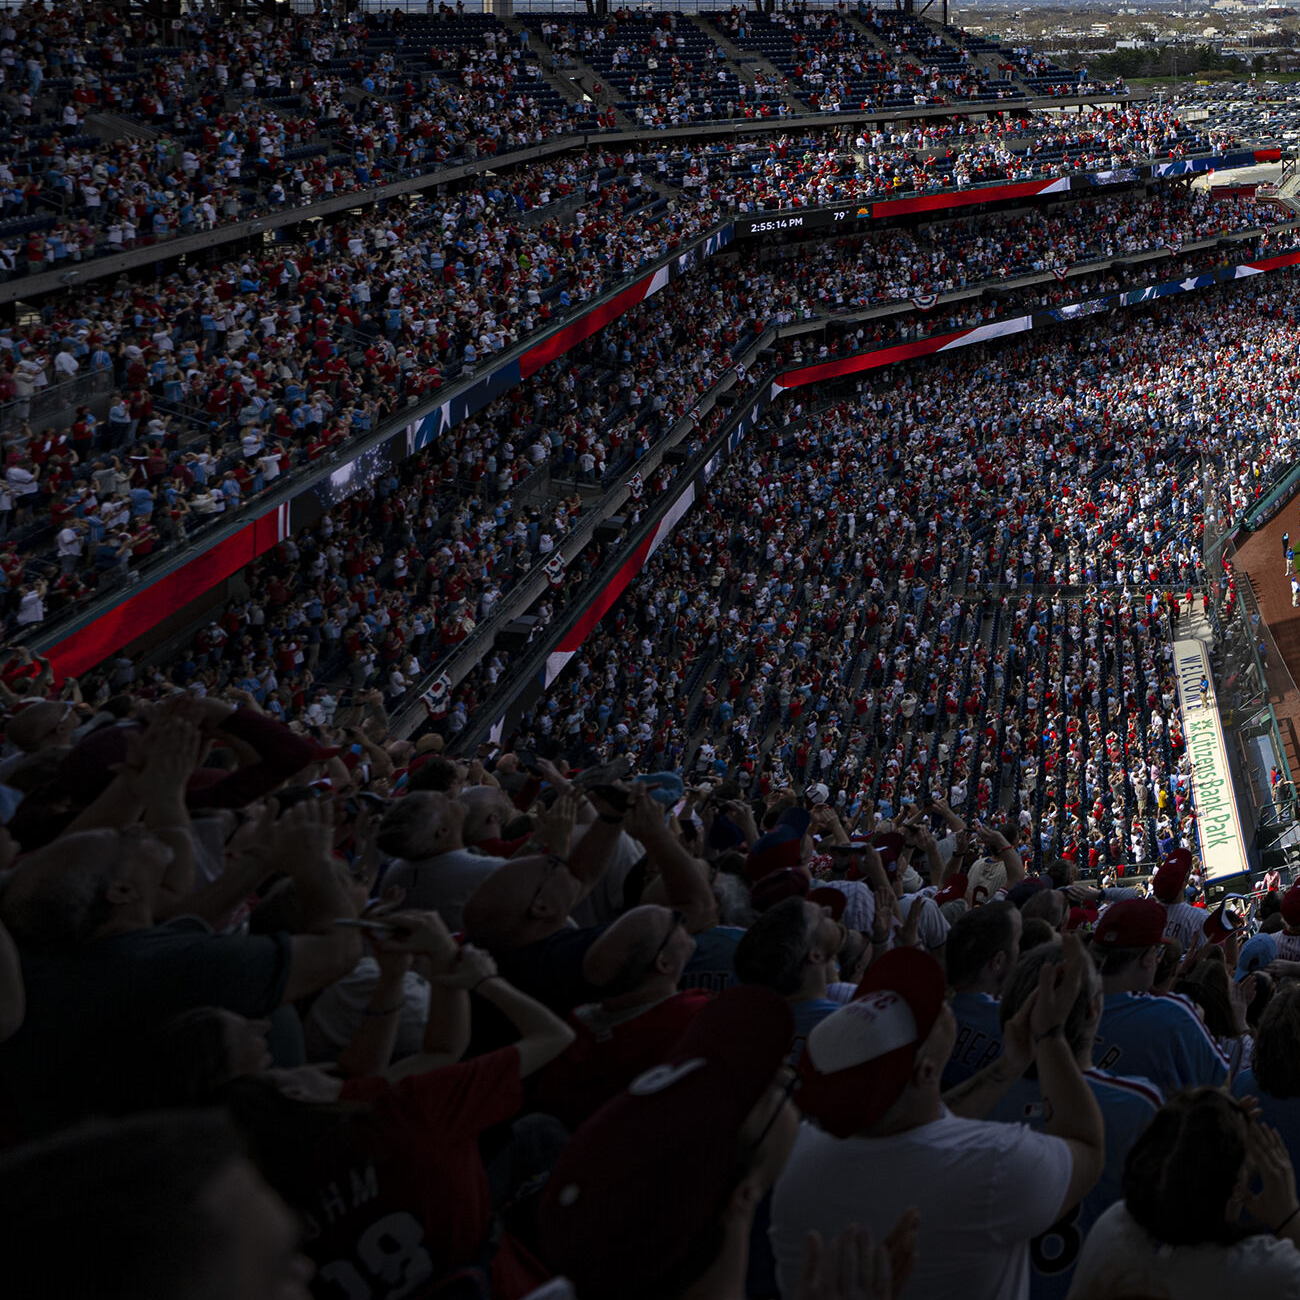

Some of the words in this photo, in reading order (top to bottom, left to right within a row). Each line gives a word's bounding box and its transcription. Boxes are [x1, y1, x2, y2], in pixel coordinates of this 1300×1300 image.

[751, 220, 787, 233] 2:55:14
[789, 217, 803, 227] PM
[1190, 731, 1215, 780] Citizens
[1200, 779, 1225, 813] Bank
[1204, 813, 1237, 849] Park
